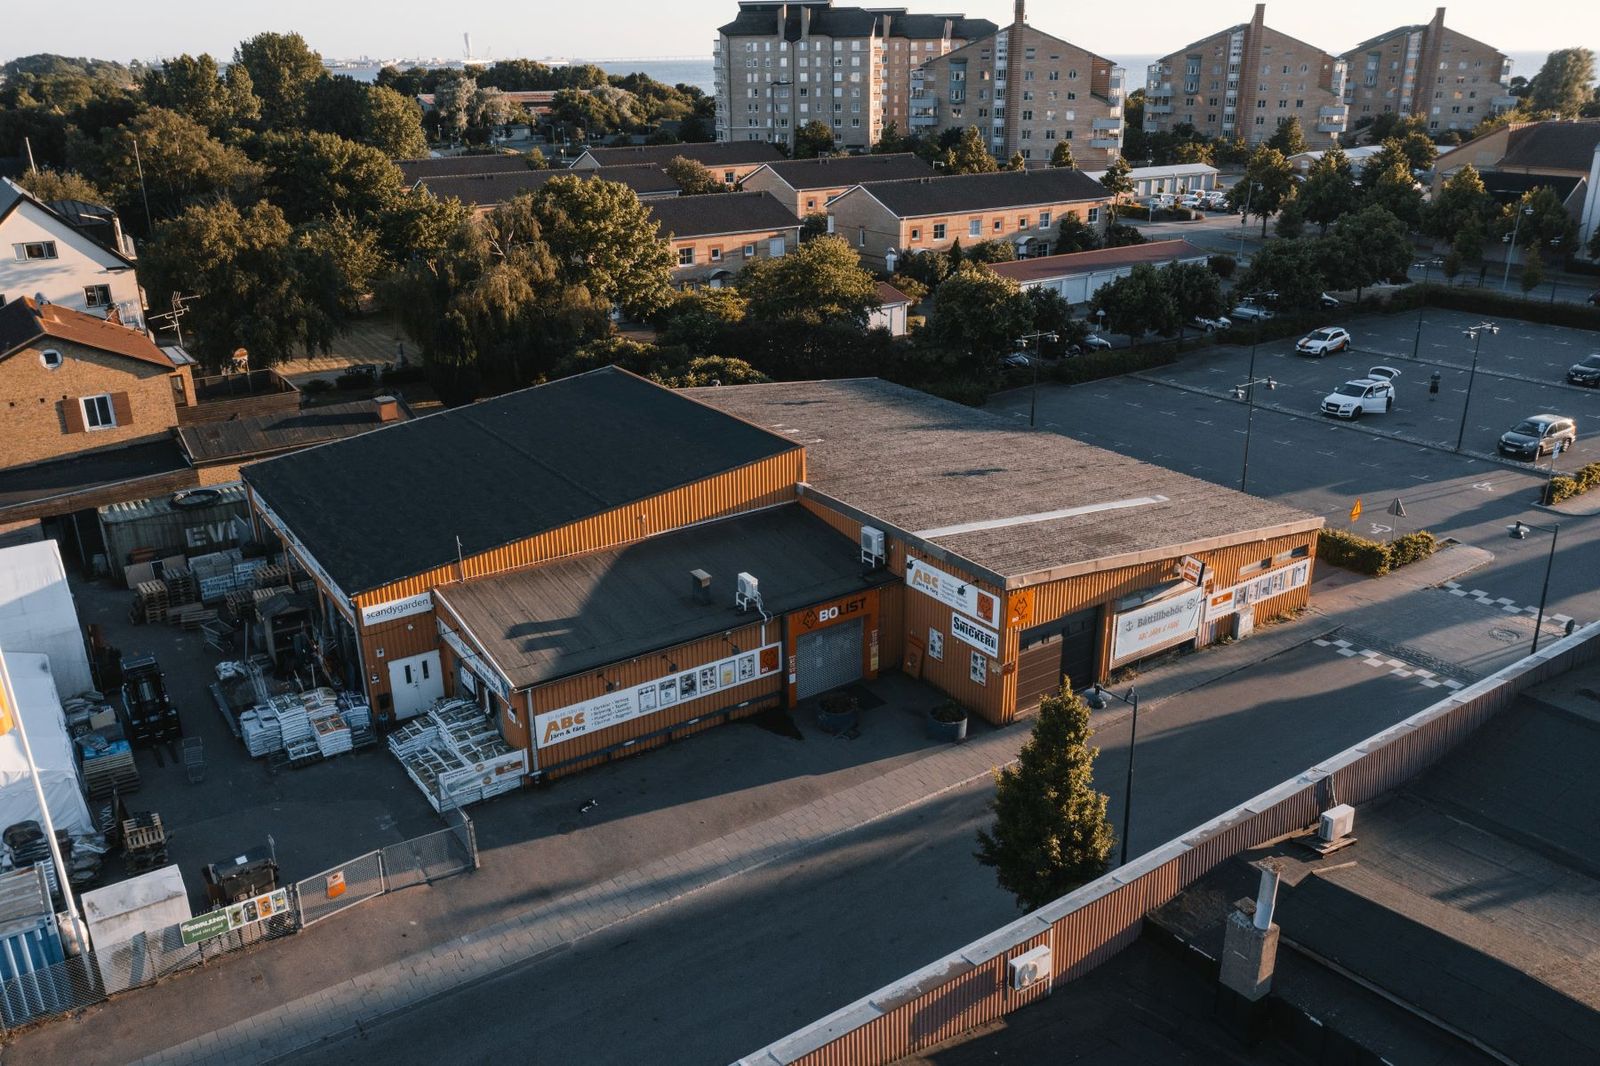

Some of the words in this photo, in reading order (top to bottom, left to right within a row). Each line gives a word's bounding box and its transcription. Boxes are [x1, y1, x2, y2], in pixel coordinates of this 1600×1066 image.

[911, 569, 939, 588] ABC
[366, 597, 428, 619] scandygarden
[819, 597, 866, 622] BOLIST
[953, 616, 996, 649] SNICKERI
[543, 712, 586, 744] ABC
